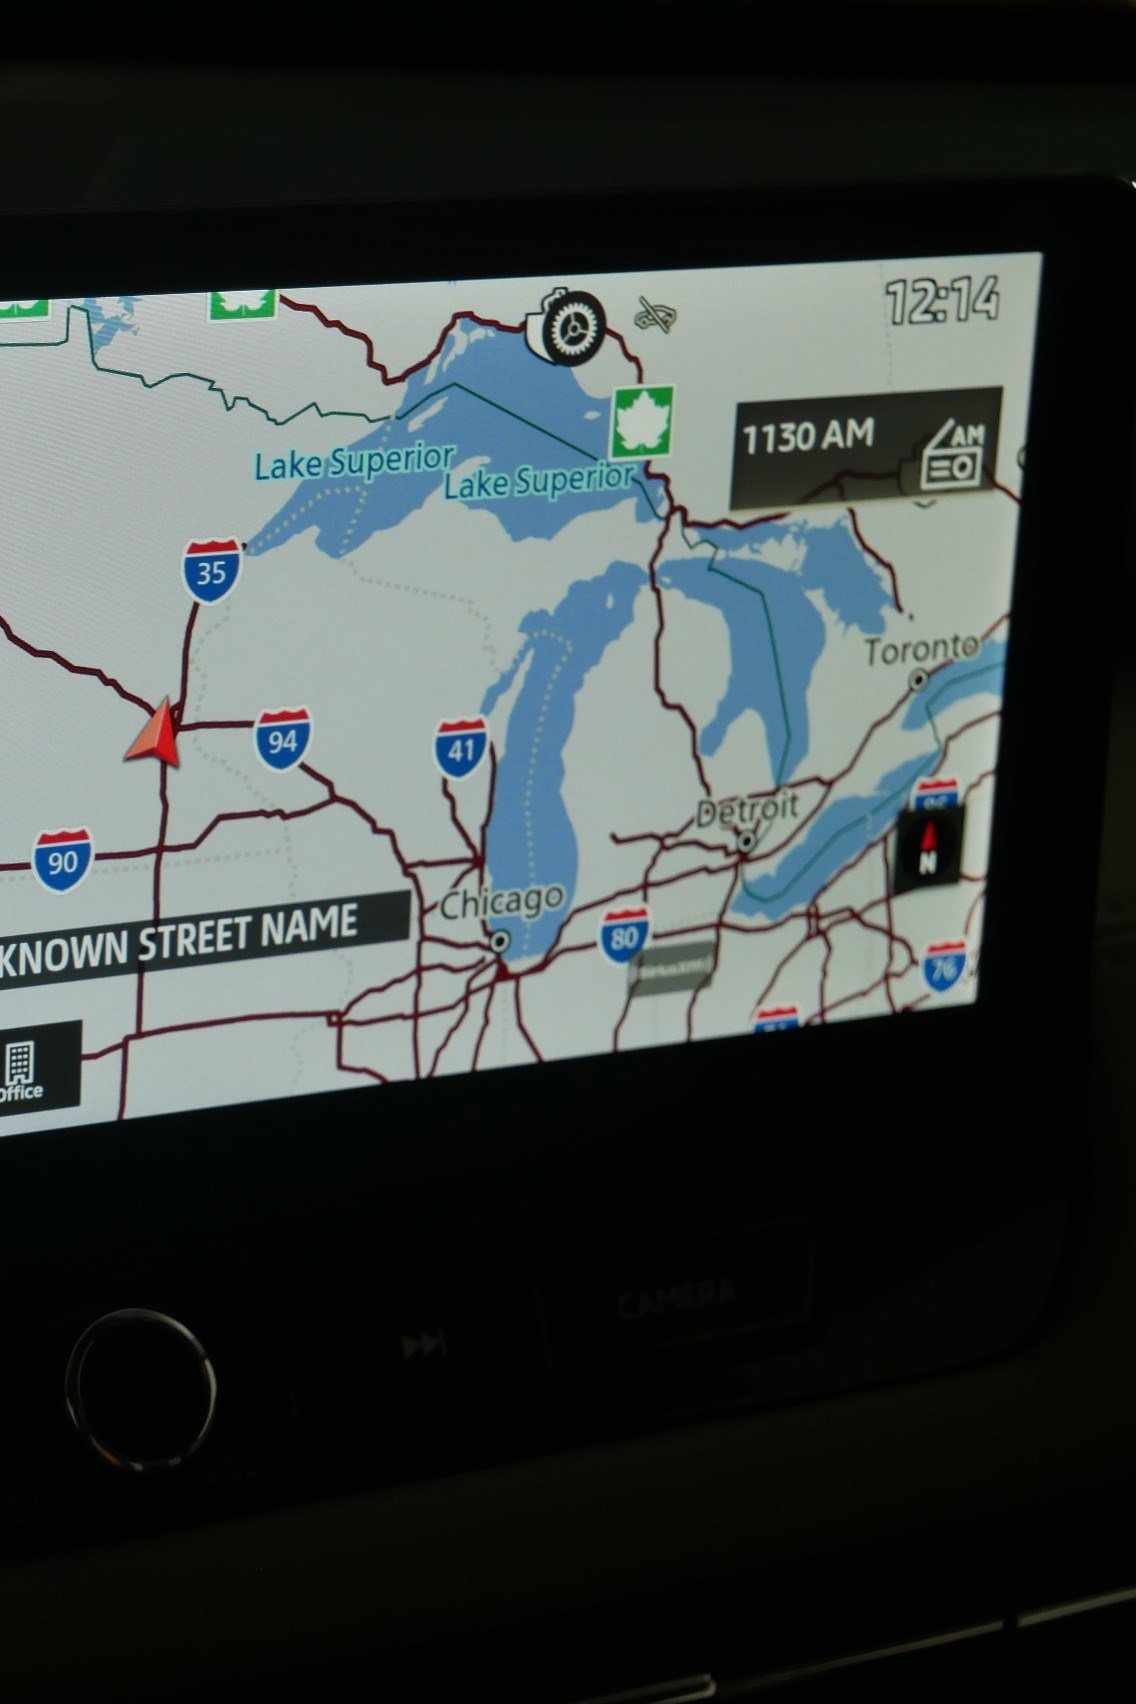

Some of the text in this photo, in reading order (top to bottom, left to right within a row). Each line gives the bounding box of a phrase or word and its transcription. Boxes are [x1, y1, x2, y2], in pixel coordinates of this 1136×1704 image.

[885, 275, 1000, 325] 12:14
[743, 417, 876, 454] 1130 AM
[950, 424, 986, 447] AM
[254, 441, 456, 482] Lake Superior
[444, 462, 635, 500] Lake Superior
[196, 561, 227, 585] 35
[865, 635, 979, 666] Toronto
[268, 729, 298, 754] 94
[447, 737, 474, 763] 41
[696, 795, 801, 828] Detroit
[47, 850, 78, 876] 90
[918, 850, 937, 876] N
[440, 884, 564, 920] Chicago
[137, 914, 253, 963] STREET
[260, 902, 360, 947] NAME
[610, 925, 639, 951] 80
[618, 1276, 739, 1319] CAMERA
